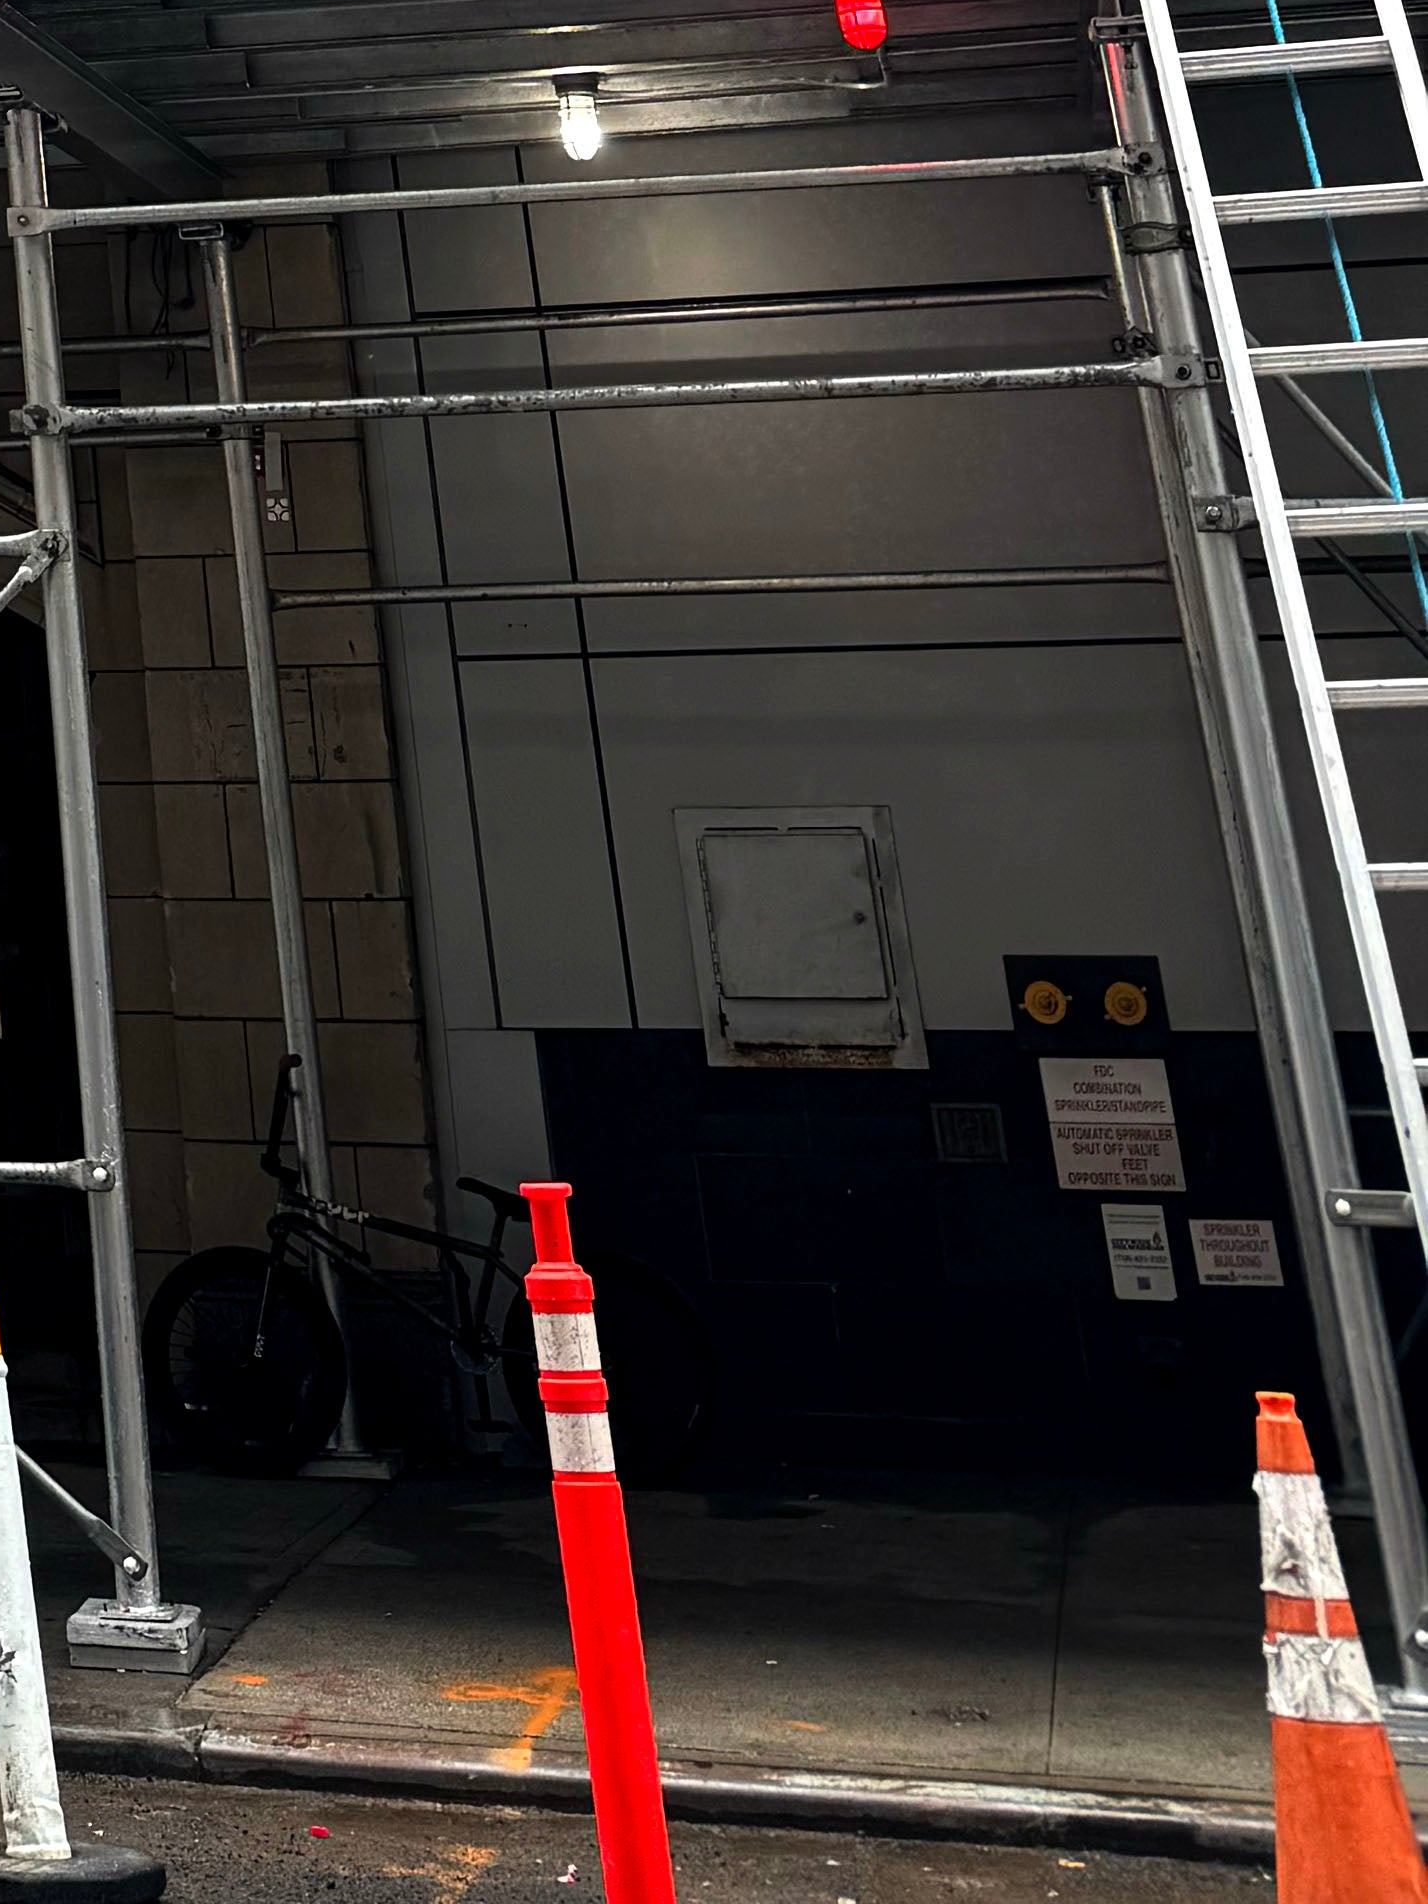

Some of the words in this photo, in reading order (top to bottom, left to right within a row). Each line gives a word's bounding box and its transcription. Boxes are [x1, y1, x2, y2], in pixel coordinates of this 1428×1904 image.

[1094, 1065, 1114, 1077] FDC
[1073, 1082, 1142, 1096] COMBINATION
[1057, 1128, 1113, 1140] AUTOMATIC
[1115, 1128, 1173, 1141] SPRINKLER
[1073, 1143, 1101, 1155] SHUT
[1103, 1143, 1124, 1156] OFF
[1127, 1143, 1160, 1157] VALVE
[1122, 1158, 1149, 1171] FEET
[1068, 1172, 1120, 1185] OPPOSITE
[1124, 1173, 1148, 1186] THIS
[1150, 1174, 1176, 1187] SIGN
[1203, 1223, 1262, 1237] SPRINKLER
[1199, 1238, 1270, 1252] THROUGHOUT
[1214, 1255, 1262, 1268] BUILDING
